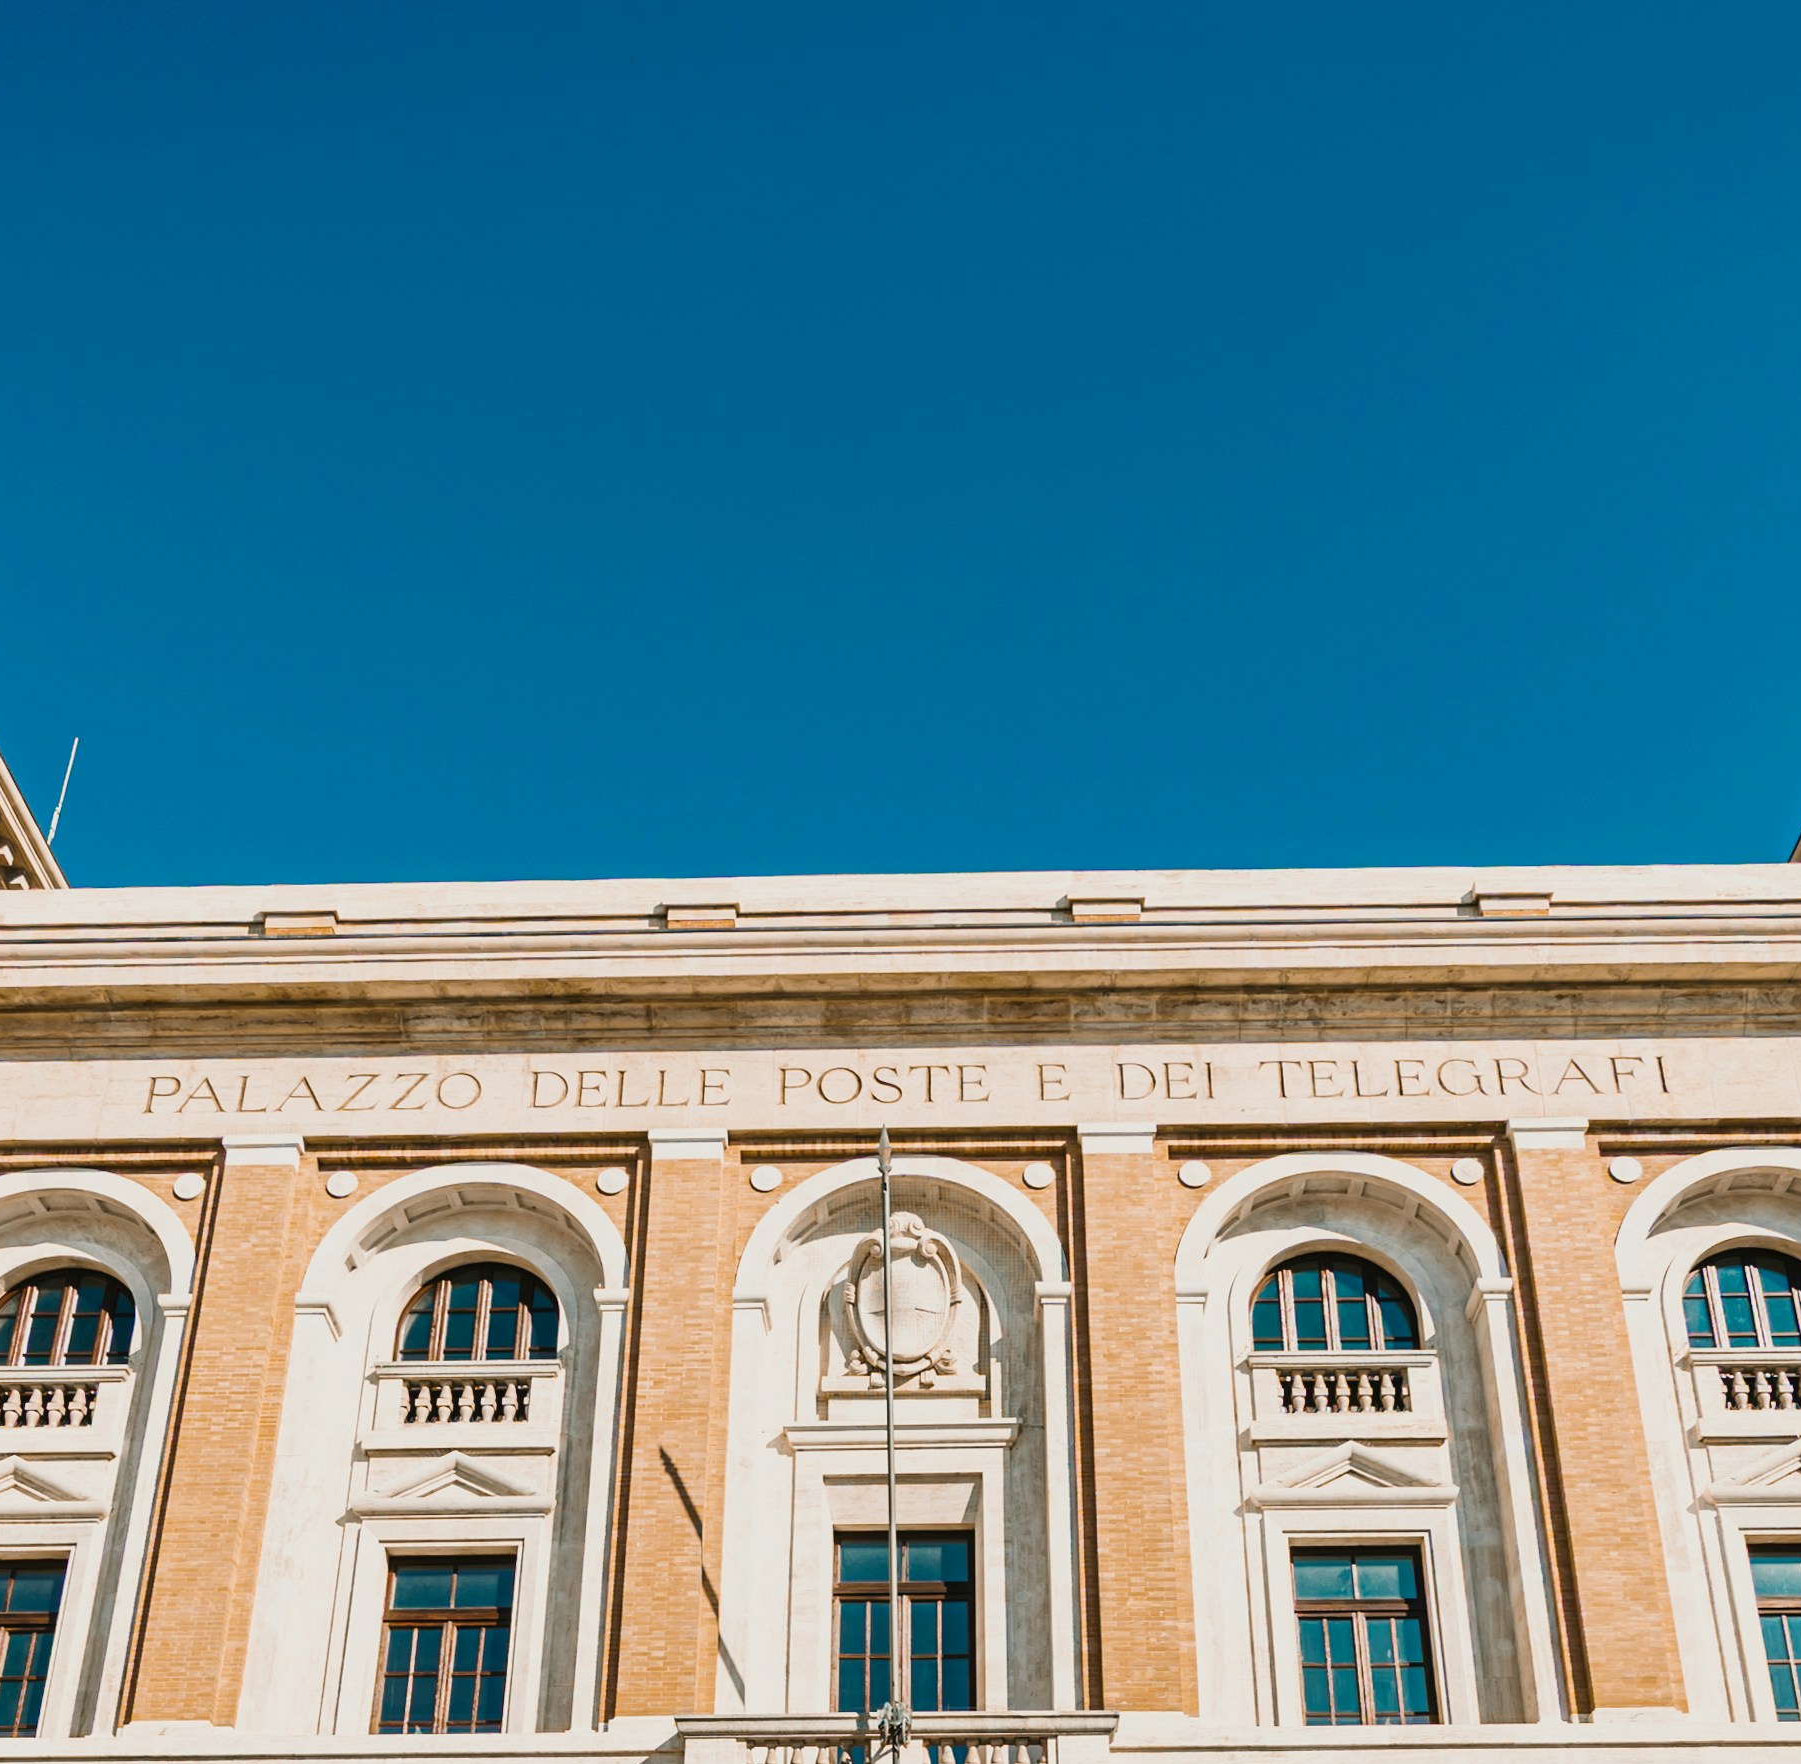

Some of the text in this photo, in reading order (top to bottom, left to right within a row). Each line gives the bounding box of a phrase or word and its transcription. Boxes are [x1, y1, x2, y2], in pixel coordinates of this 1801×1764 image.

[142, 1055, 1671, 1115] PALAZZO DELLE POSTE E DEI TELEGRAFI
